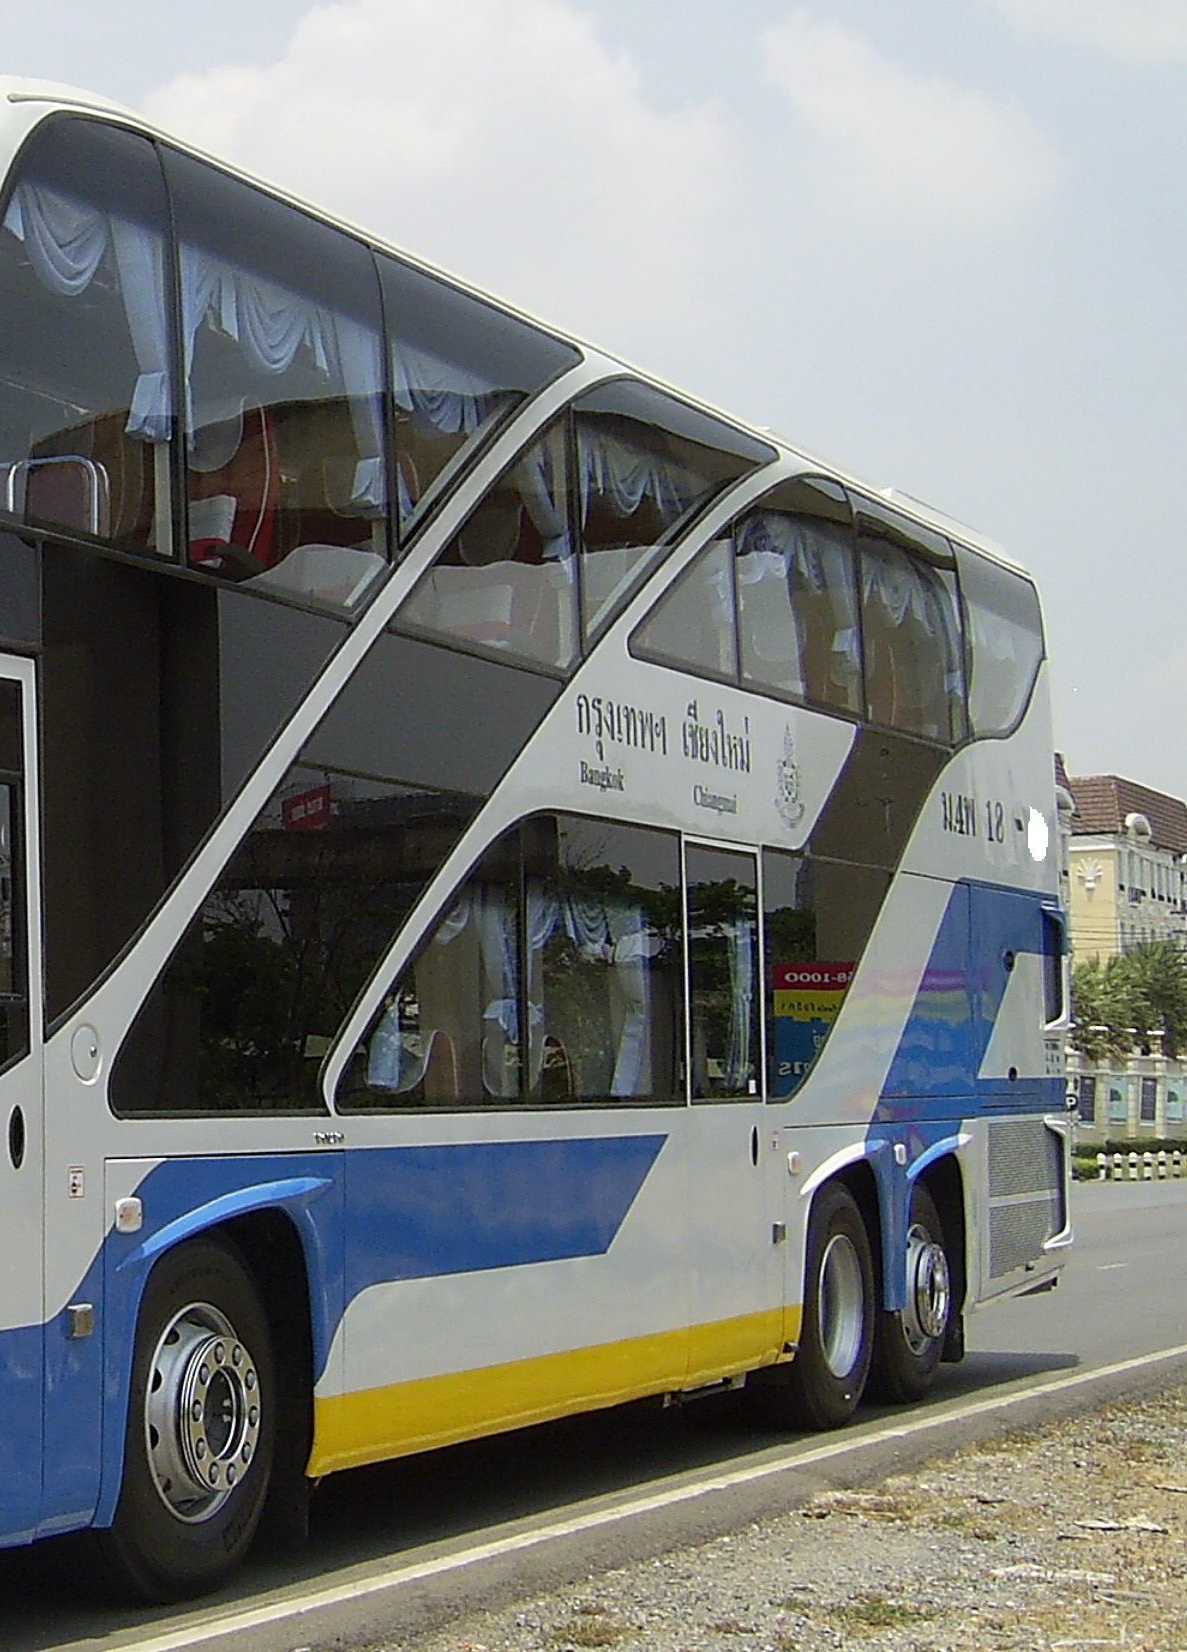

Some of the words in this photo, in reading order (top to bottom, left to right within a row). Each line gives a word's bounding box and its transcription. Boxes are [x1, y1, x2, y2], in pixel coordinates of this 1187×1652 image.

[576, 694, 667, 761] กรุงเทพฯ
[682, 699, 751, 772] เชียงใหม่
[579, 761, 625, 793] Bangkok
